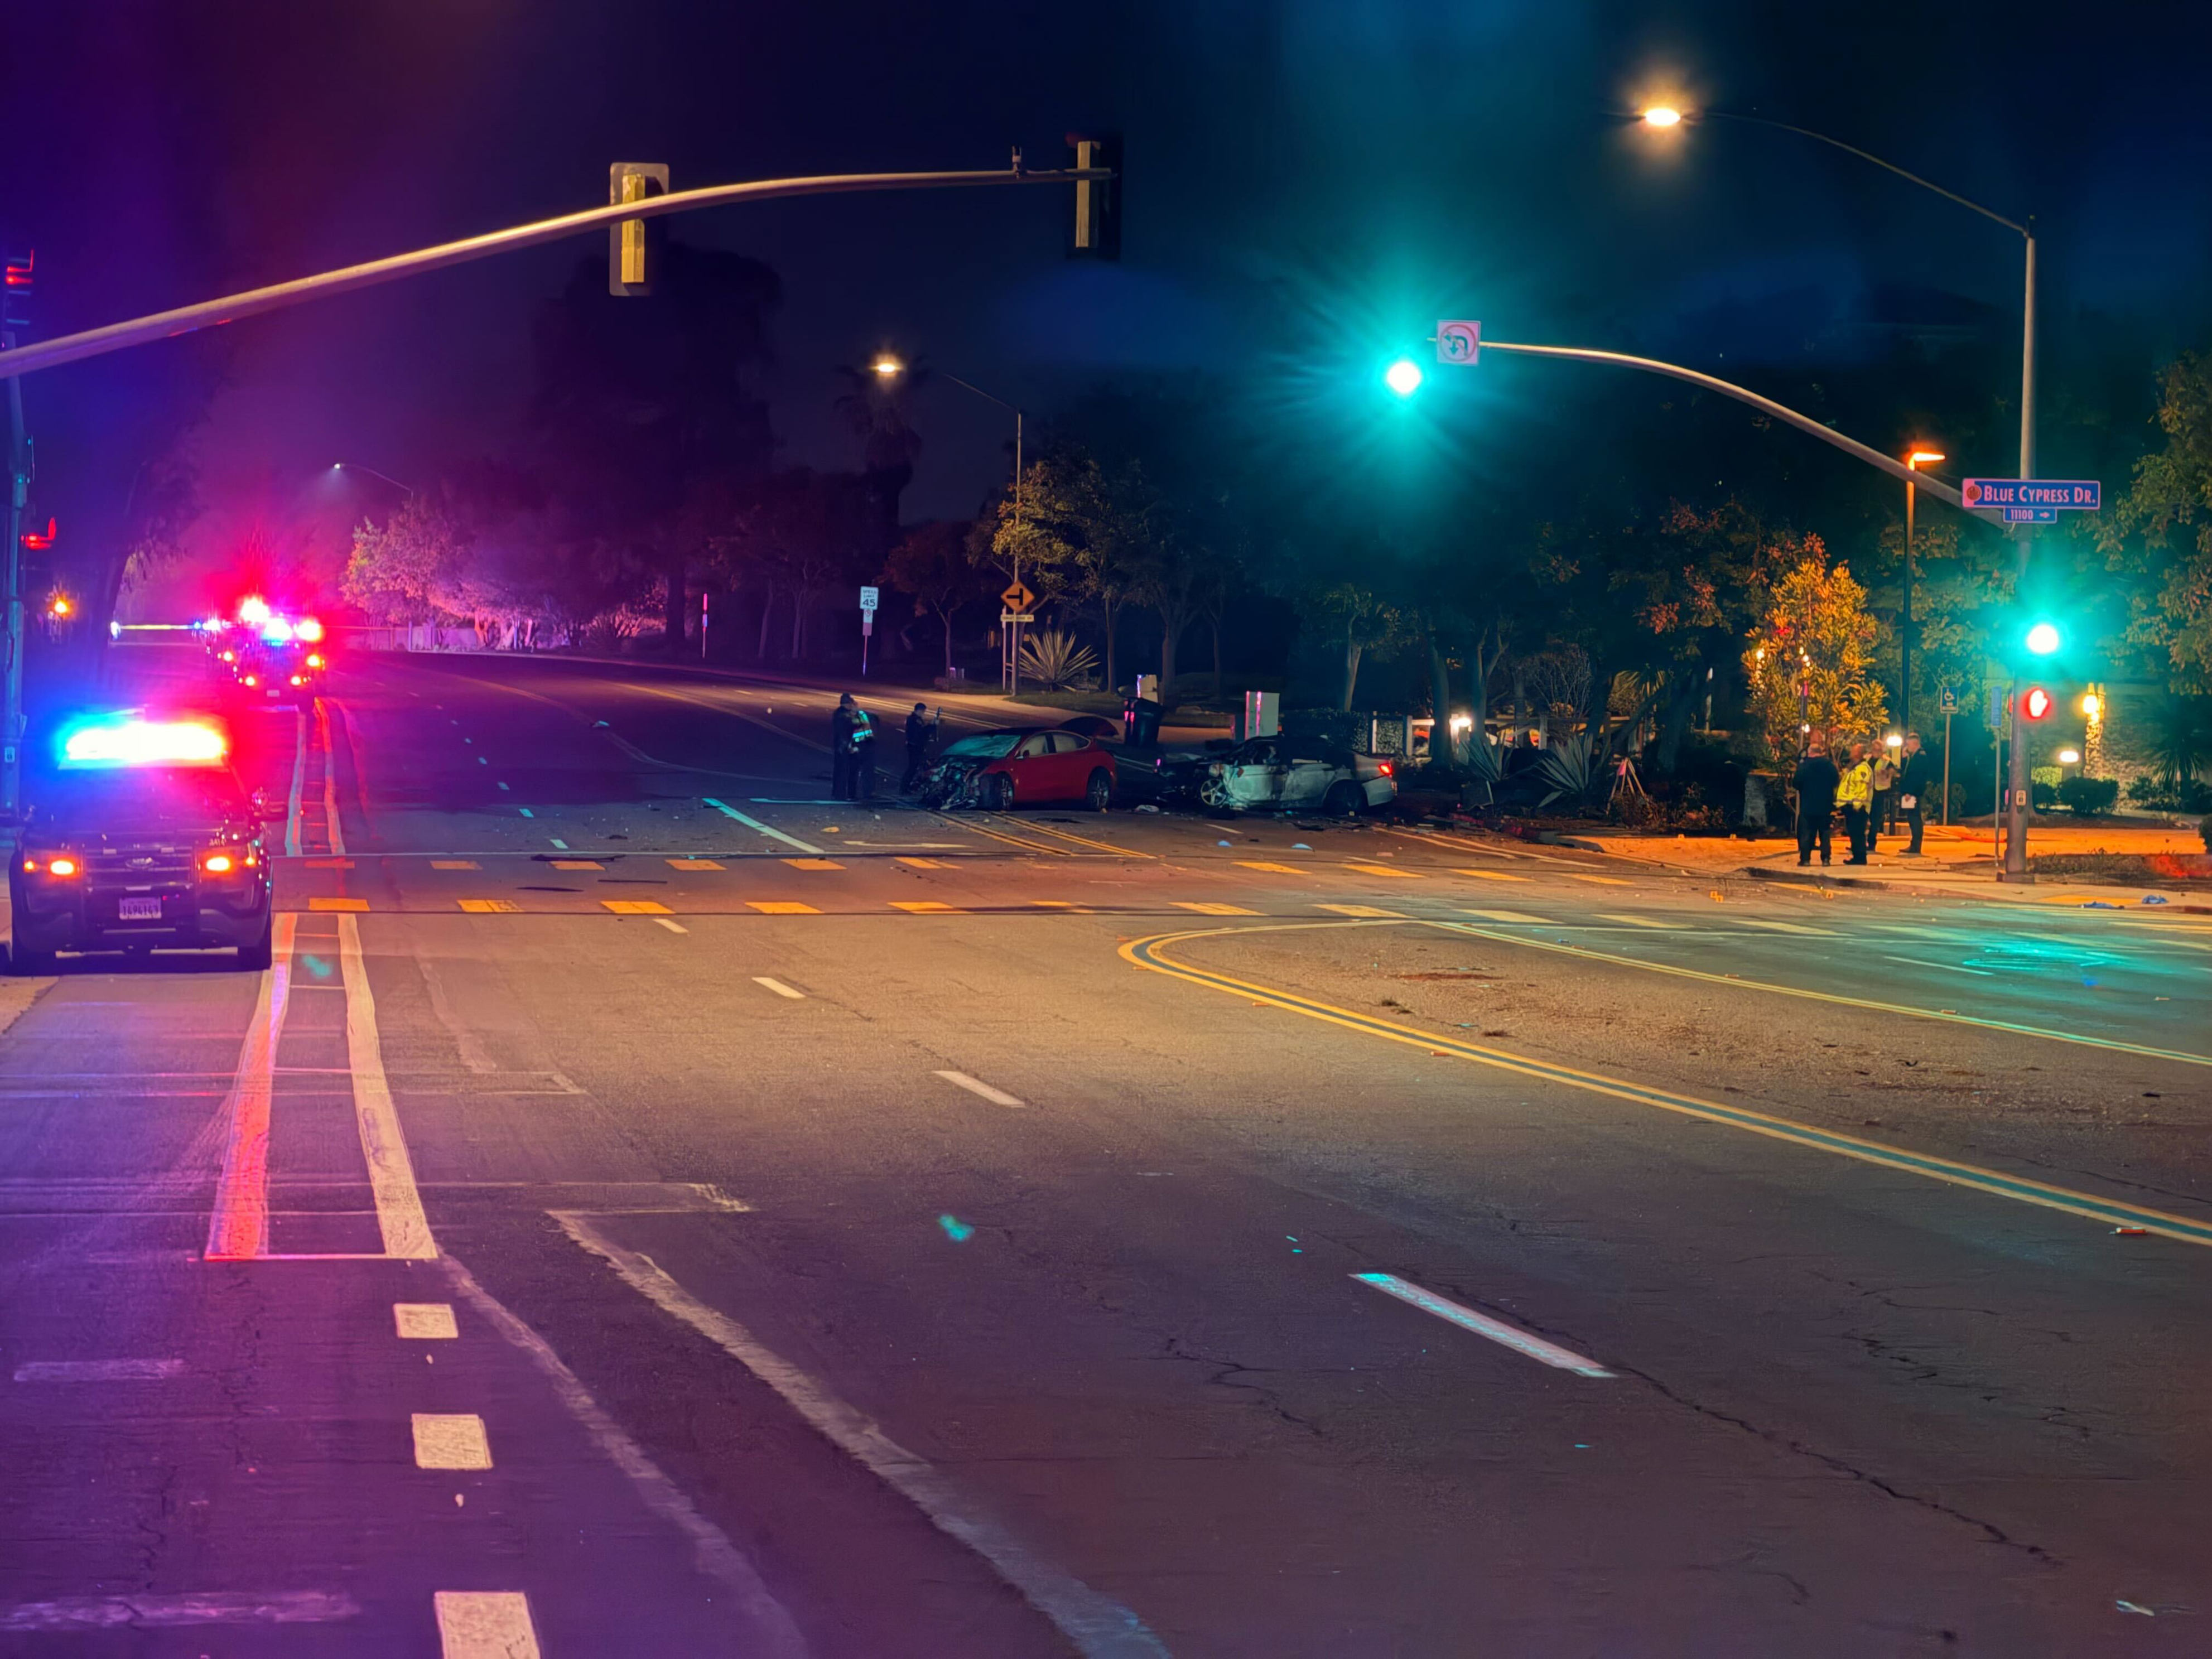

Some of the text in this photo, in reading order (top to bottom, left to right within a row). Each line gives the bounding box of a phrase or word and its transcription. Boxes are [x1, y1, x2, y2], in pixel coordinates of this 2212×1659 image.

[1984, 485, 2096, 504] BLUE CYPRESS DR.
[2010, 509, 2033, 520] 11100
[862, 599, 875, 607] 45
